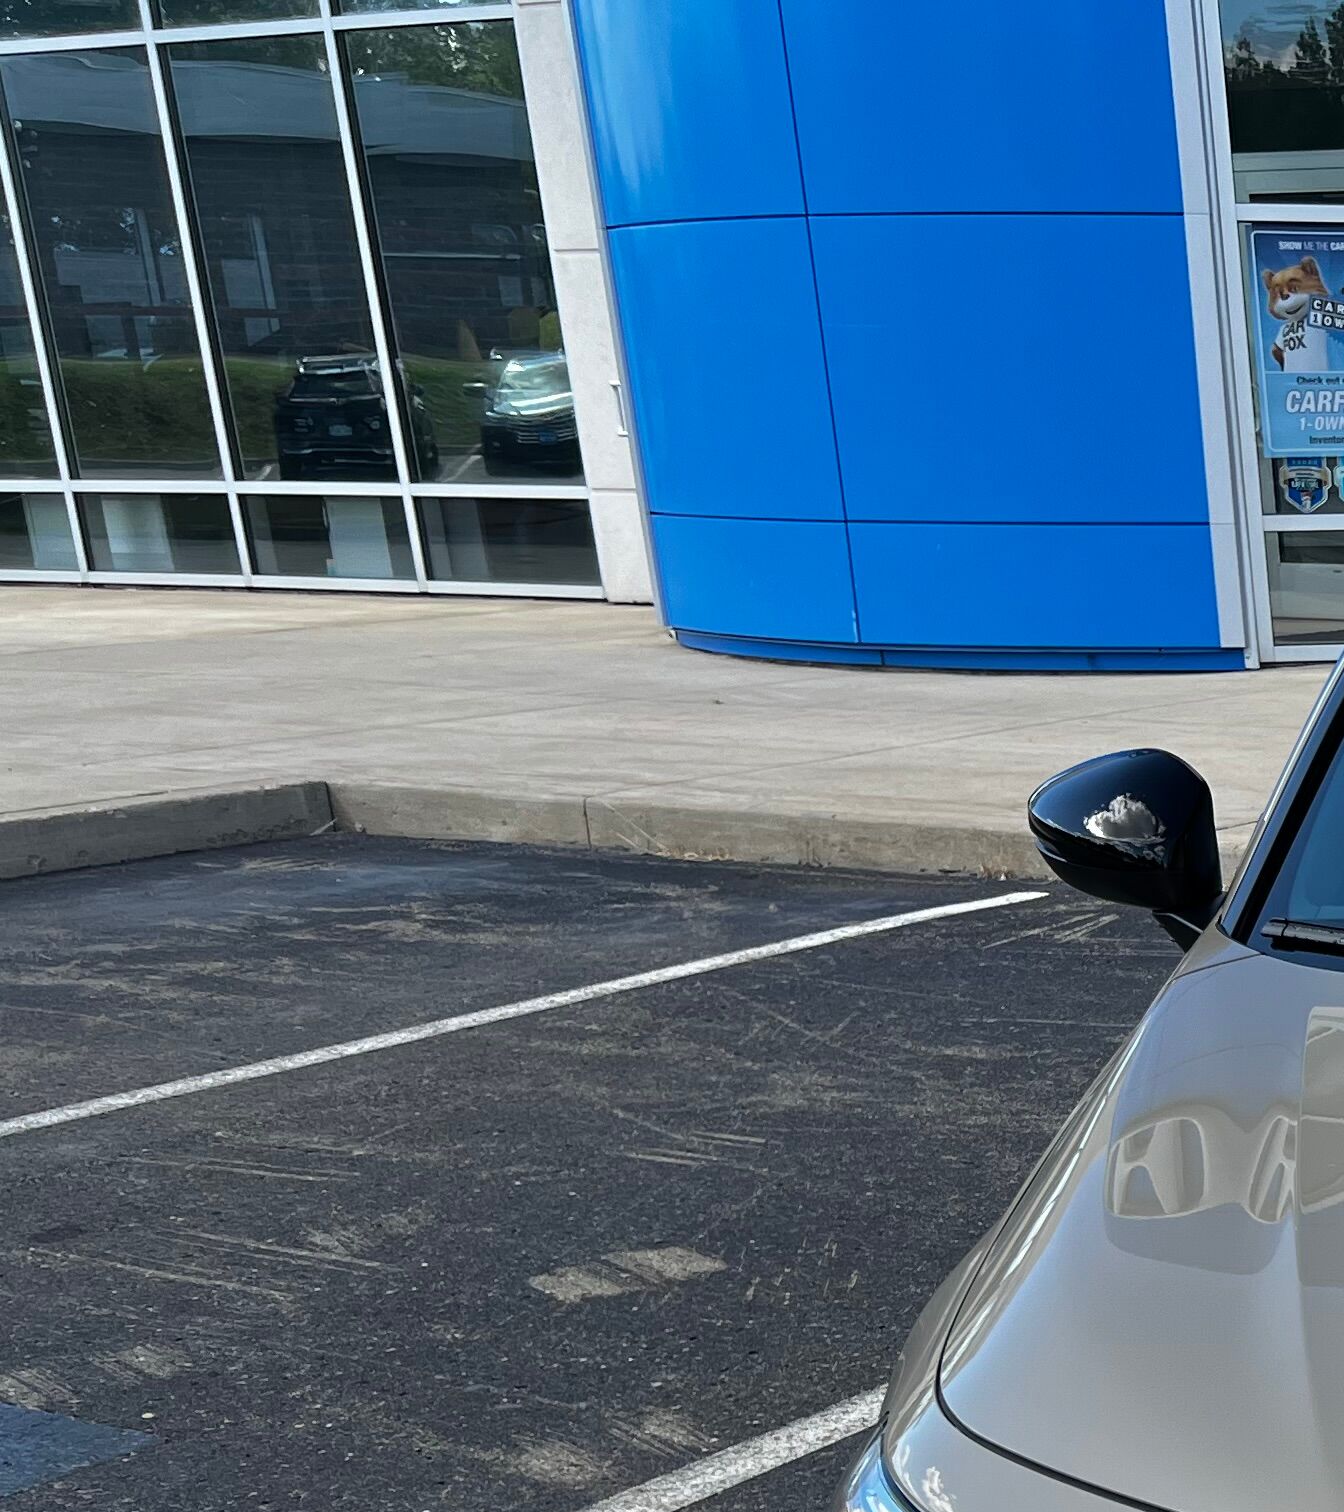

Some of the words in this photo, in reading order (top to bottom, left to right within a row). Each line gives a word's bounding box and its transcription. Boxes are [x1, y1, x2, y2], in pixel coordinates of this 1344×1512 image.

[1278, 241, 1302, 251] SHOW
[1283, 321, 1305, 338] CAR
[1284, 335, 1307, 351] FOX
[1296, 376, 1323, 385] Check
[1326, 376, 1340, 385] out
